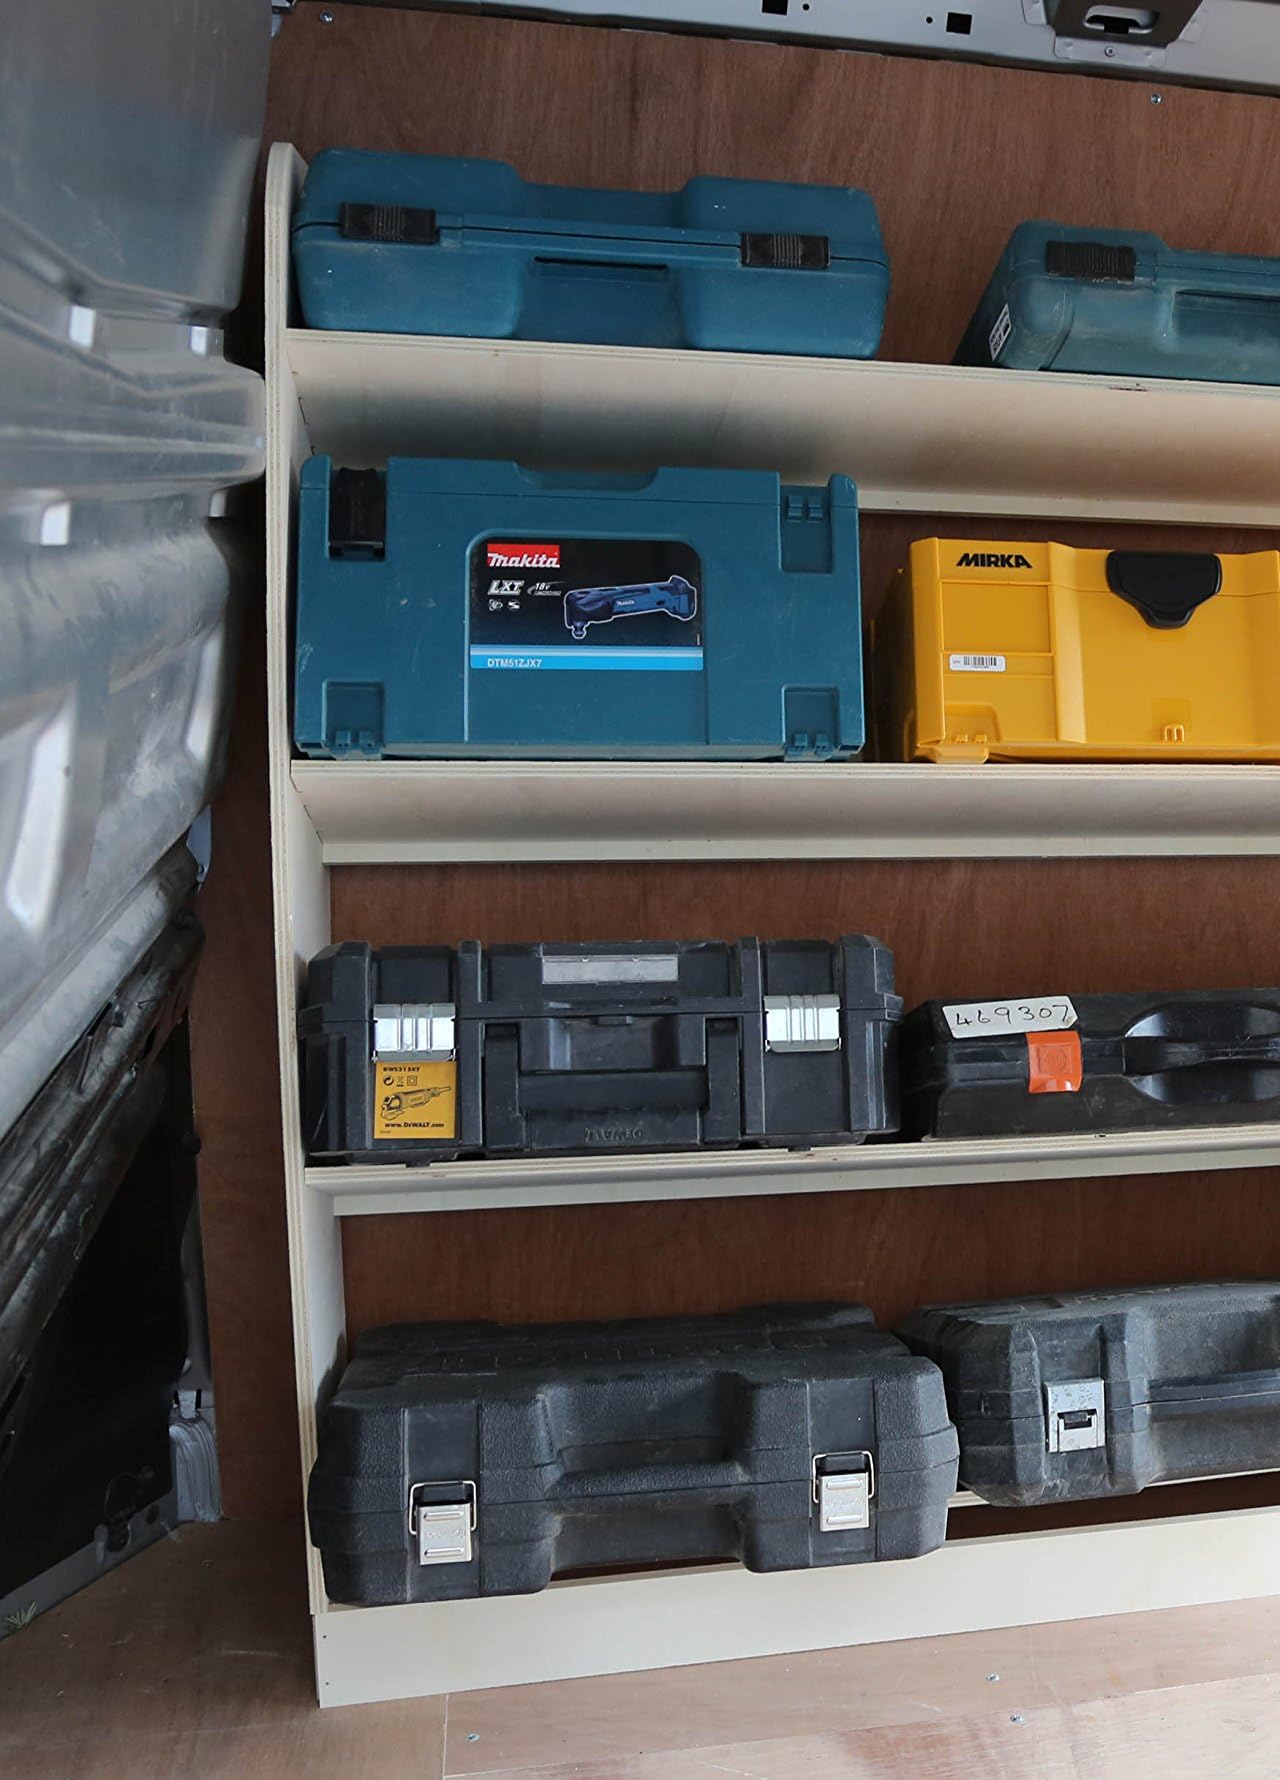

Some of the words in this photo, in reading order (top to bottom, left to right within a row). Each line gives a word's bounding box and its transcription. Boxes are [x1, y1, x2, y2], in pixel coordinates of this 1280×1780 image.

[956, 552, 1033, 569] MIRKA
[487, 580, 525, 595] LXT
[487, 658, 542, 668] DTM51ZJX7
[956, 1004, 1069, 1026] 469307
